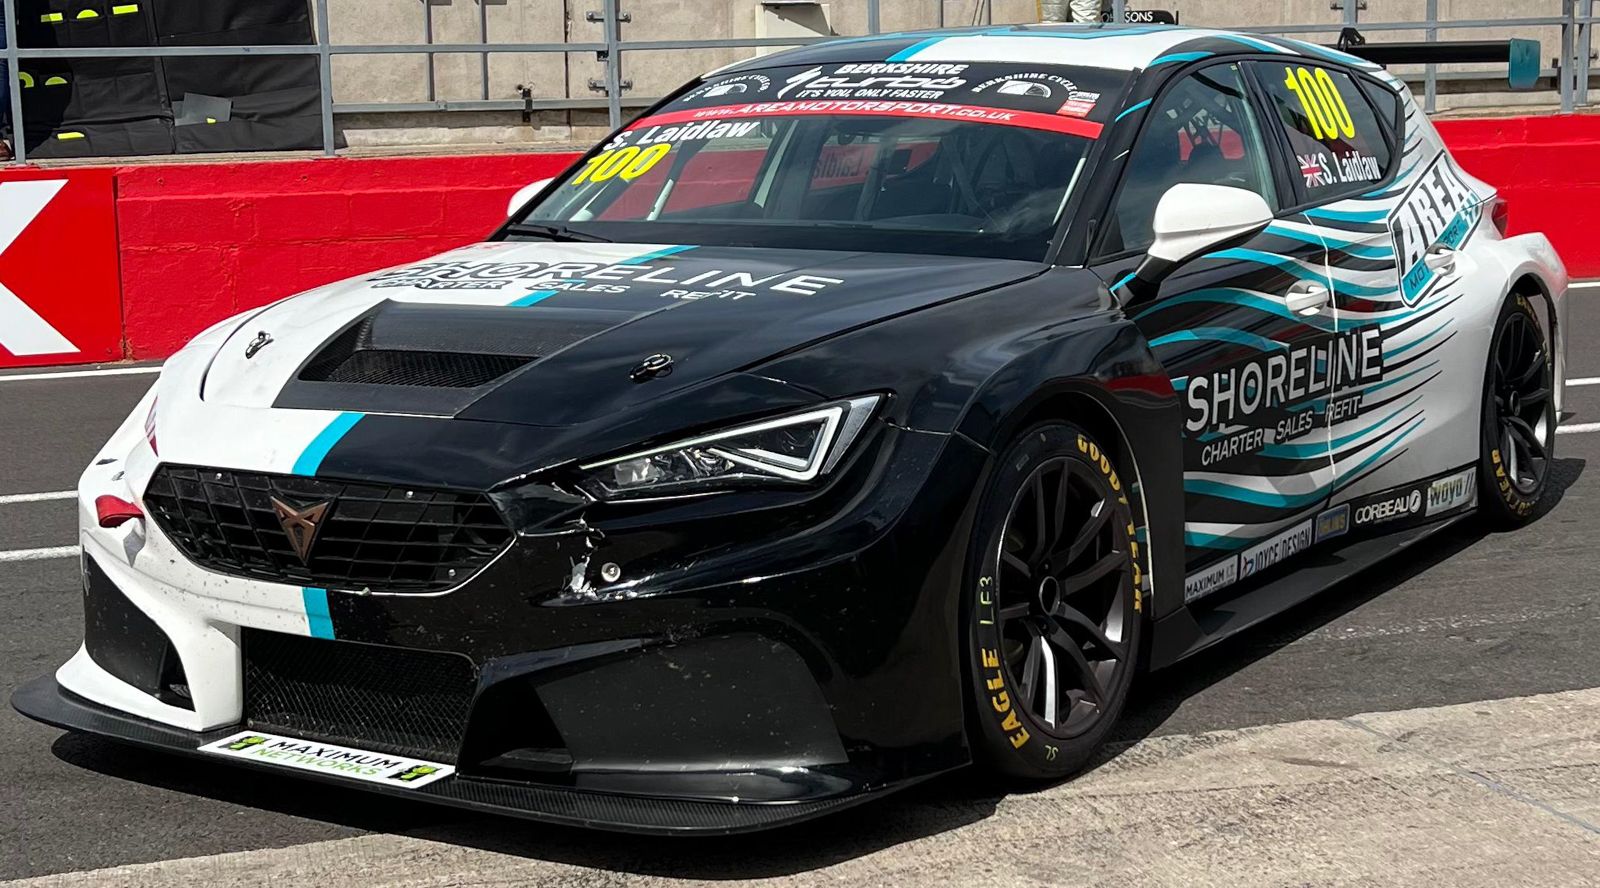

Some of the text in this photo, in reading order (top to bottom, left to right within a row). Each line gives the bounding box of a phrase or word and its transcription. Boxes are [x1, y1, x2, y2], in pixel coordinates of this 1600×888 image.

[834, 63, 969, 75] BERKSHIRE
[971, 72, 1079, 93] BERKSHIRE CYCLE
[854, 88, 890, 98] ONLY
[885, 89, 944, 100] FASTER
[1284, 66, 1356, 140] 100
[602, 119, 761, 150] S. Laidlaw
[571, 143, 672, 186] 100
[1317, 150, 1382, 185] S. Laidlaw
[1399, 156, 1468, 277] AREA
[370, 261, 844, 296] SHORELINE
[375, 278, 507, 290] CHARTER
[532, 281, 631, 293] SALES
[1186, 326, 1382, 432] SHORELINE
[1201, 395, 1362, 467] CHARTER SALES REFIT
[1355, 495, 1410, 524] CORBEAU
[1186, 568, 1225, 599] MAXIMUM
[981, 648, 1031, 749] EAGLE
[251, 748, 383, 775] NETWORKS
[269, 740, 403, 769] MAXIMUM
